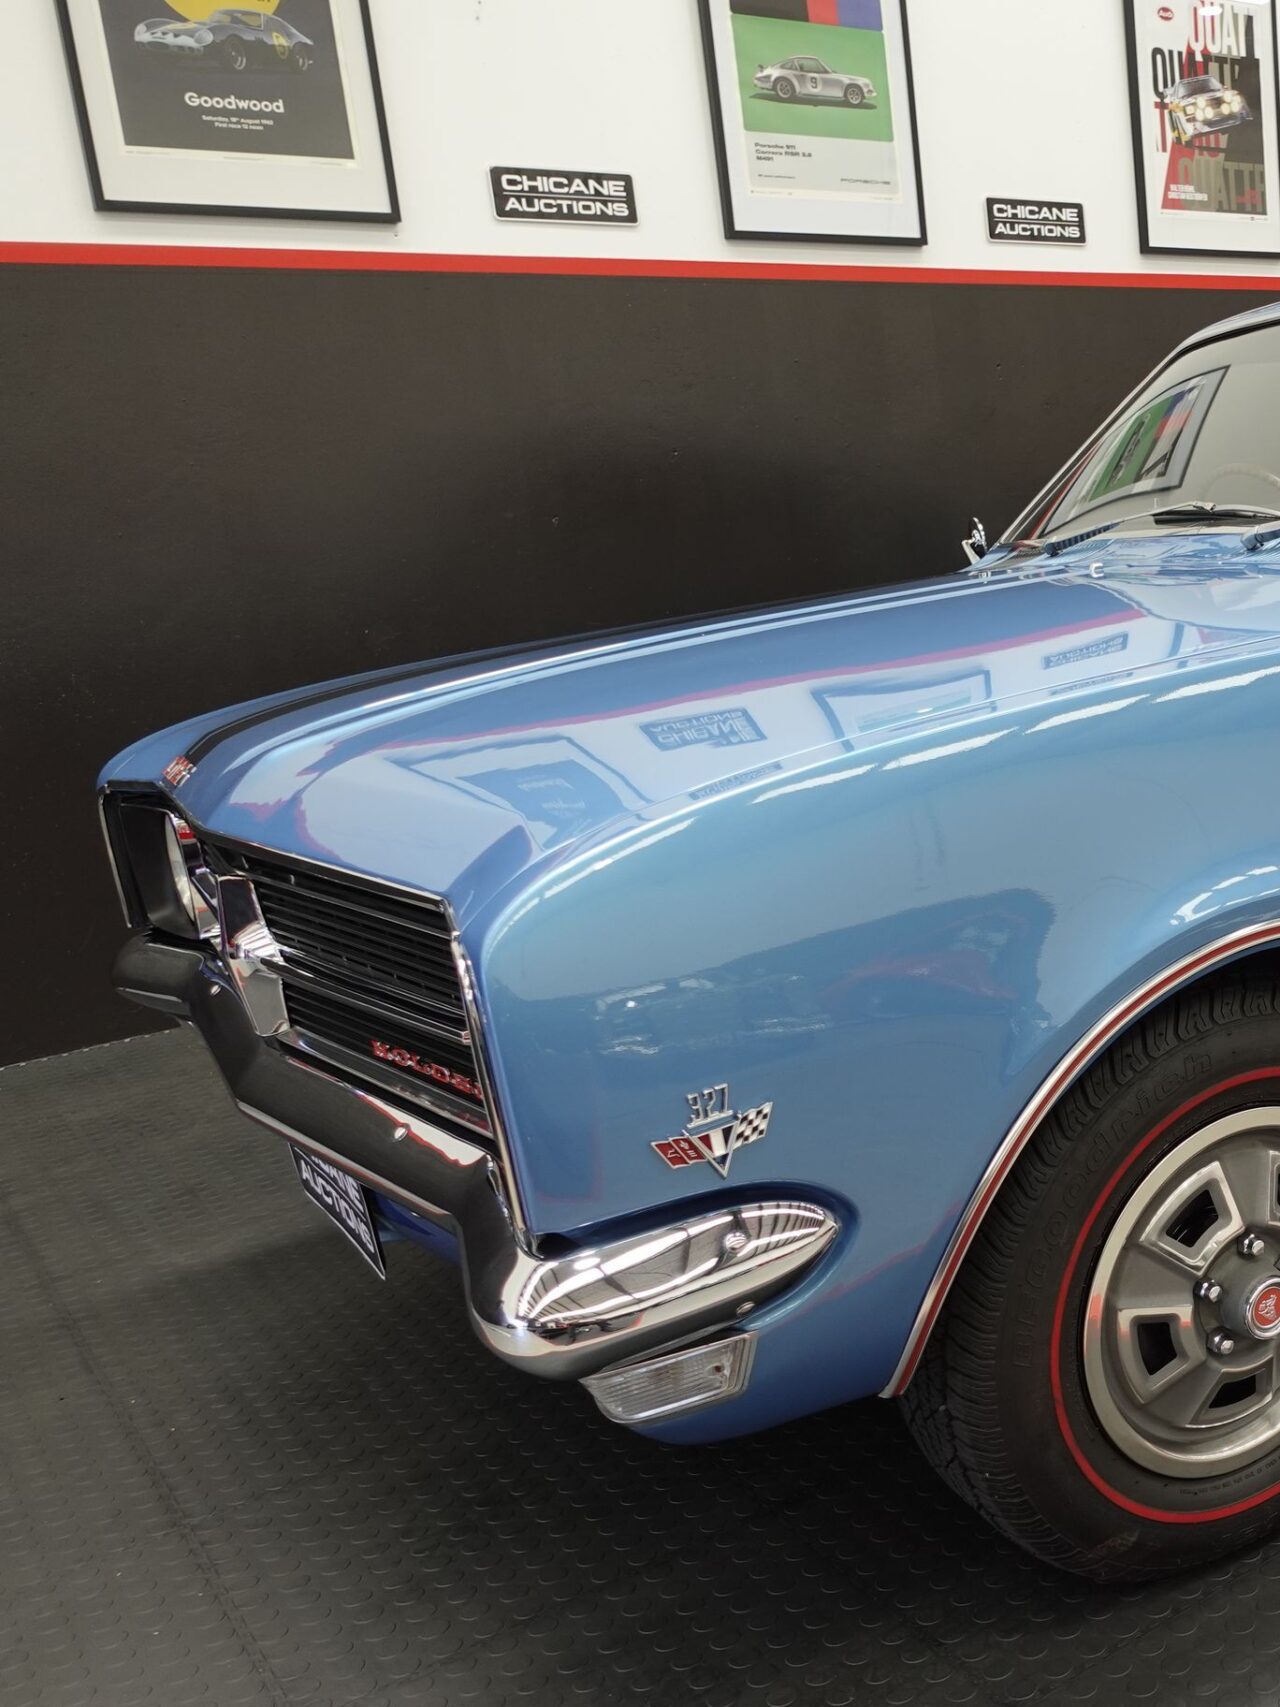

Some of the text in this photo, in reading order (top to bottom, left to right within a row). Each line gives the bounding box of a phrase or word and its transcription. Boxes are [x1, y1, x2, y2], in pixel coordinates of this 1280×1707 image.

[183, 91, 285, 113] Goodwood
[500, 173, 628, 197] CHICANE
[504, 197, 630, 217] AUCTIONS
[992, 203, 1080, 222] CHICANE
[994, 222, 1081, 238] AUCTIONS
